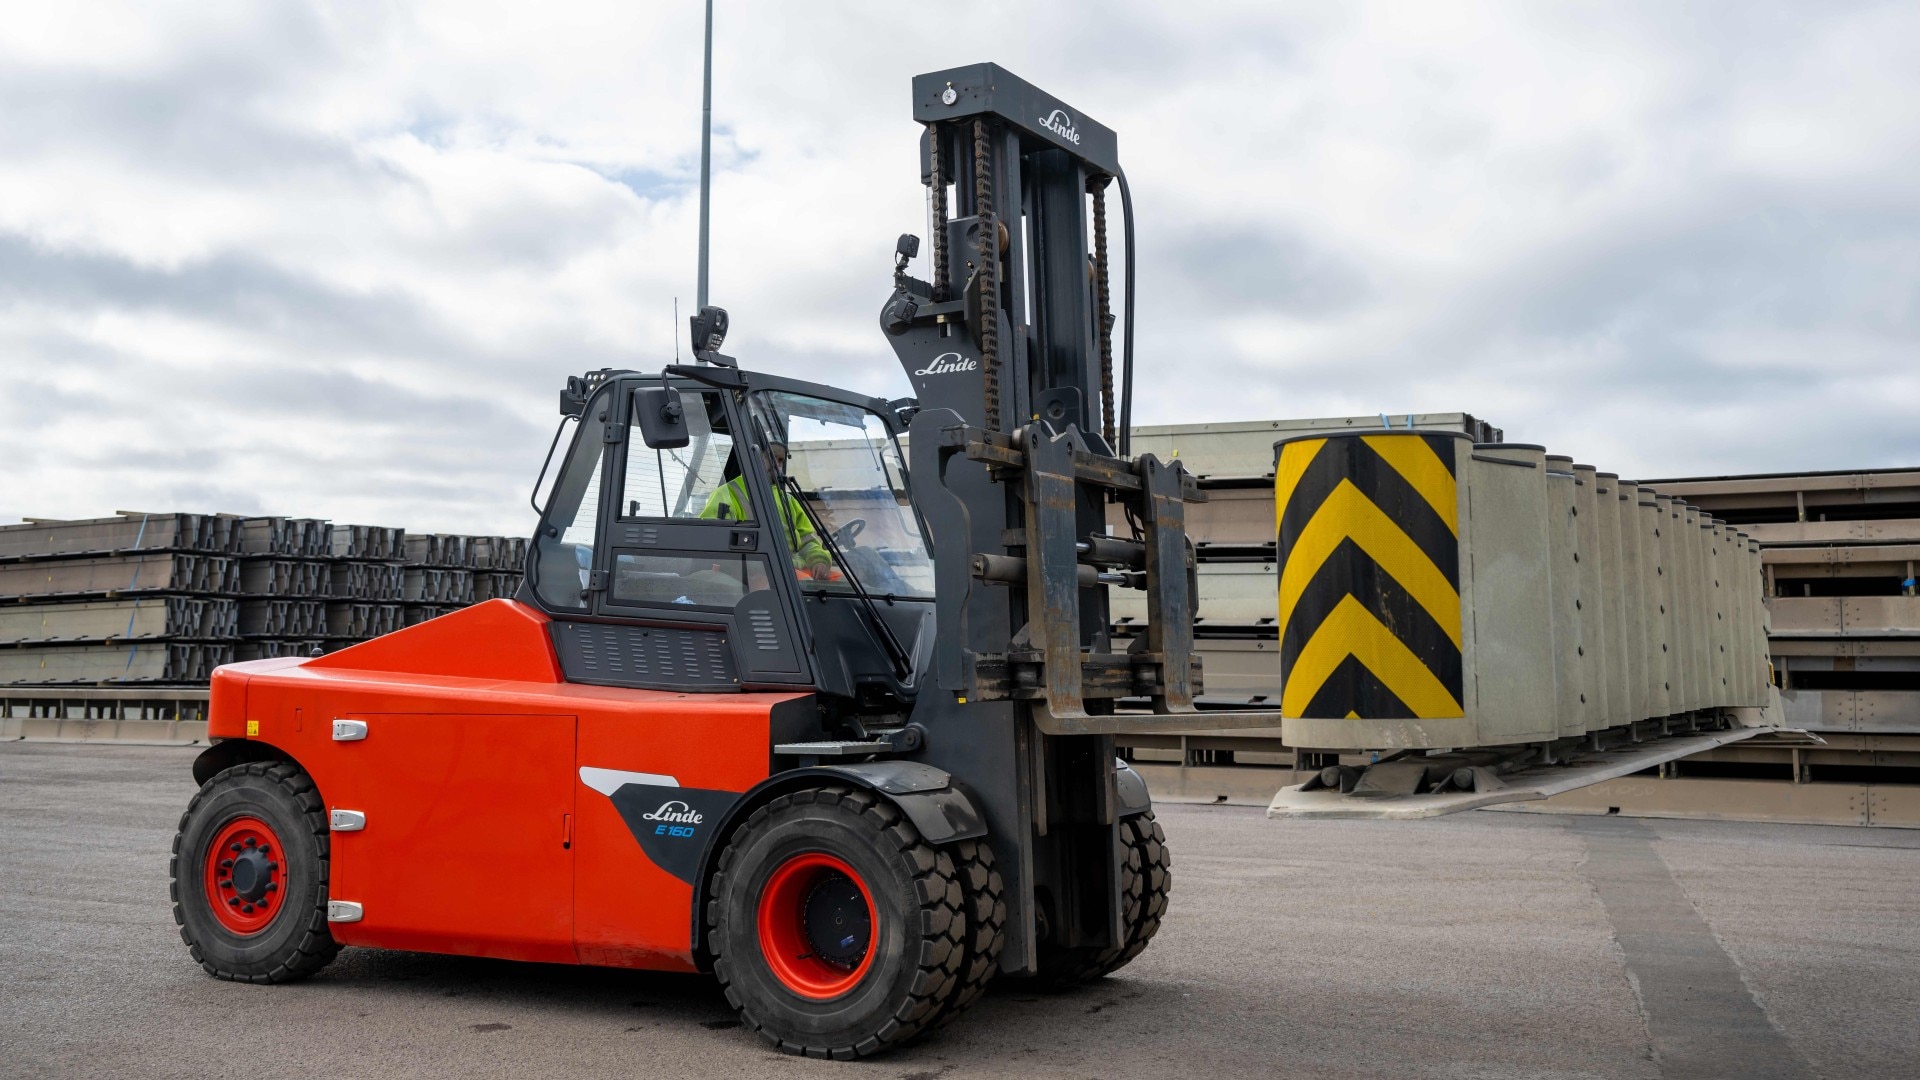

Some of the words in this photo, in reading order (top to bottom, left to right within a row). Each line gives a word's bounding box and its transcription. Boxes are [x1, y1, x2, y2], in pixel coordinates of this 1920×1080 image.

[1038, 109, 1080, 146] Linde
[914, 352, 977, 376] Linde
[642, 800, 703, 824] Linde
[668, 826, 695, 838] 160
